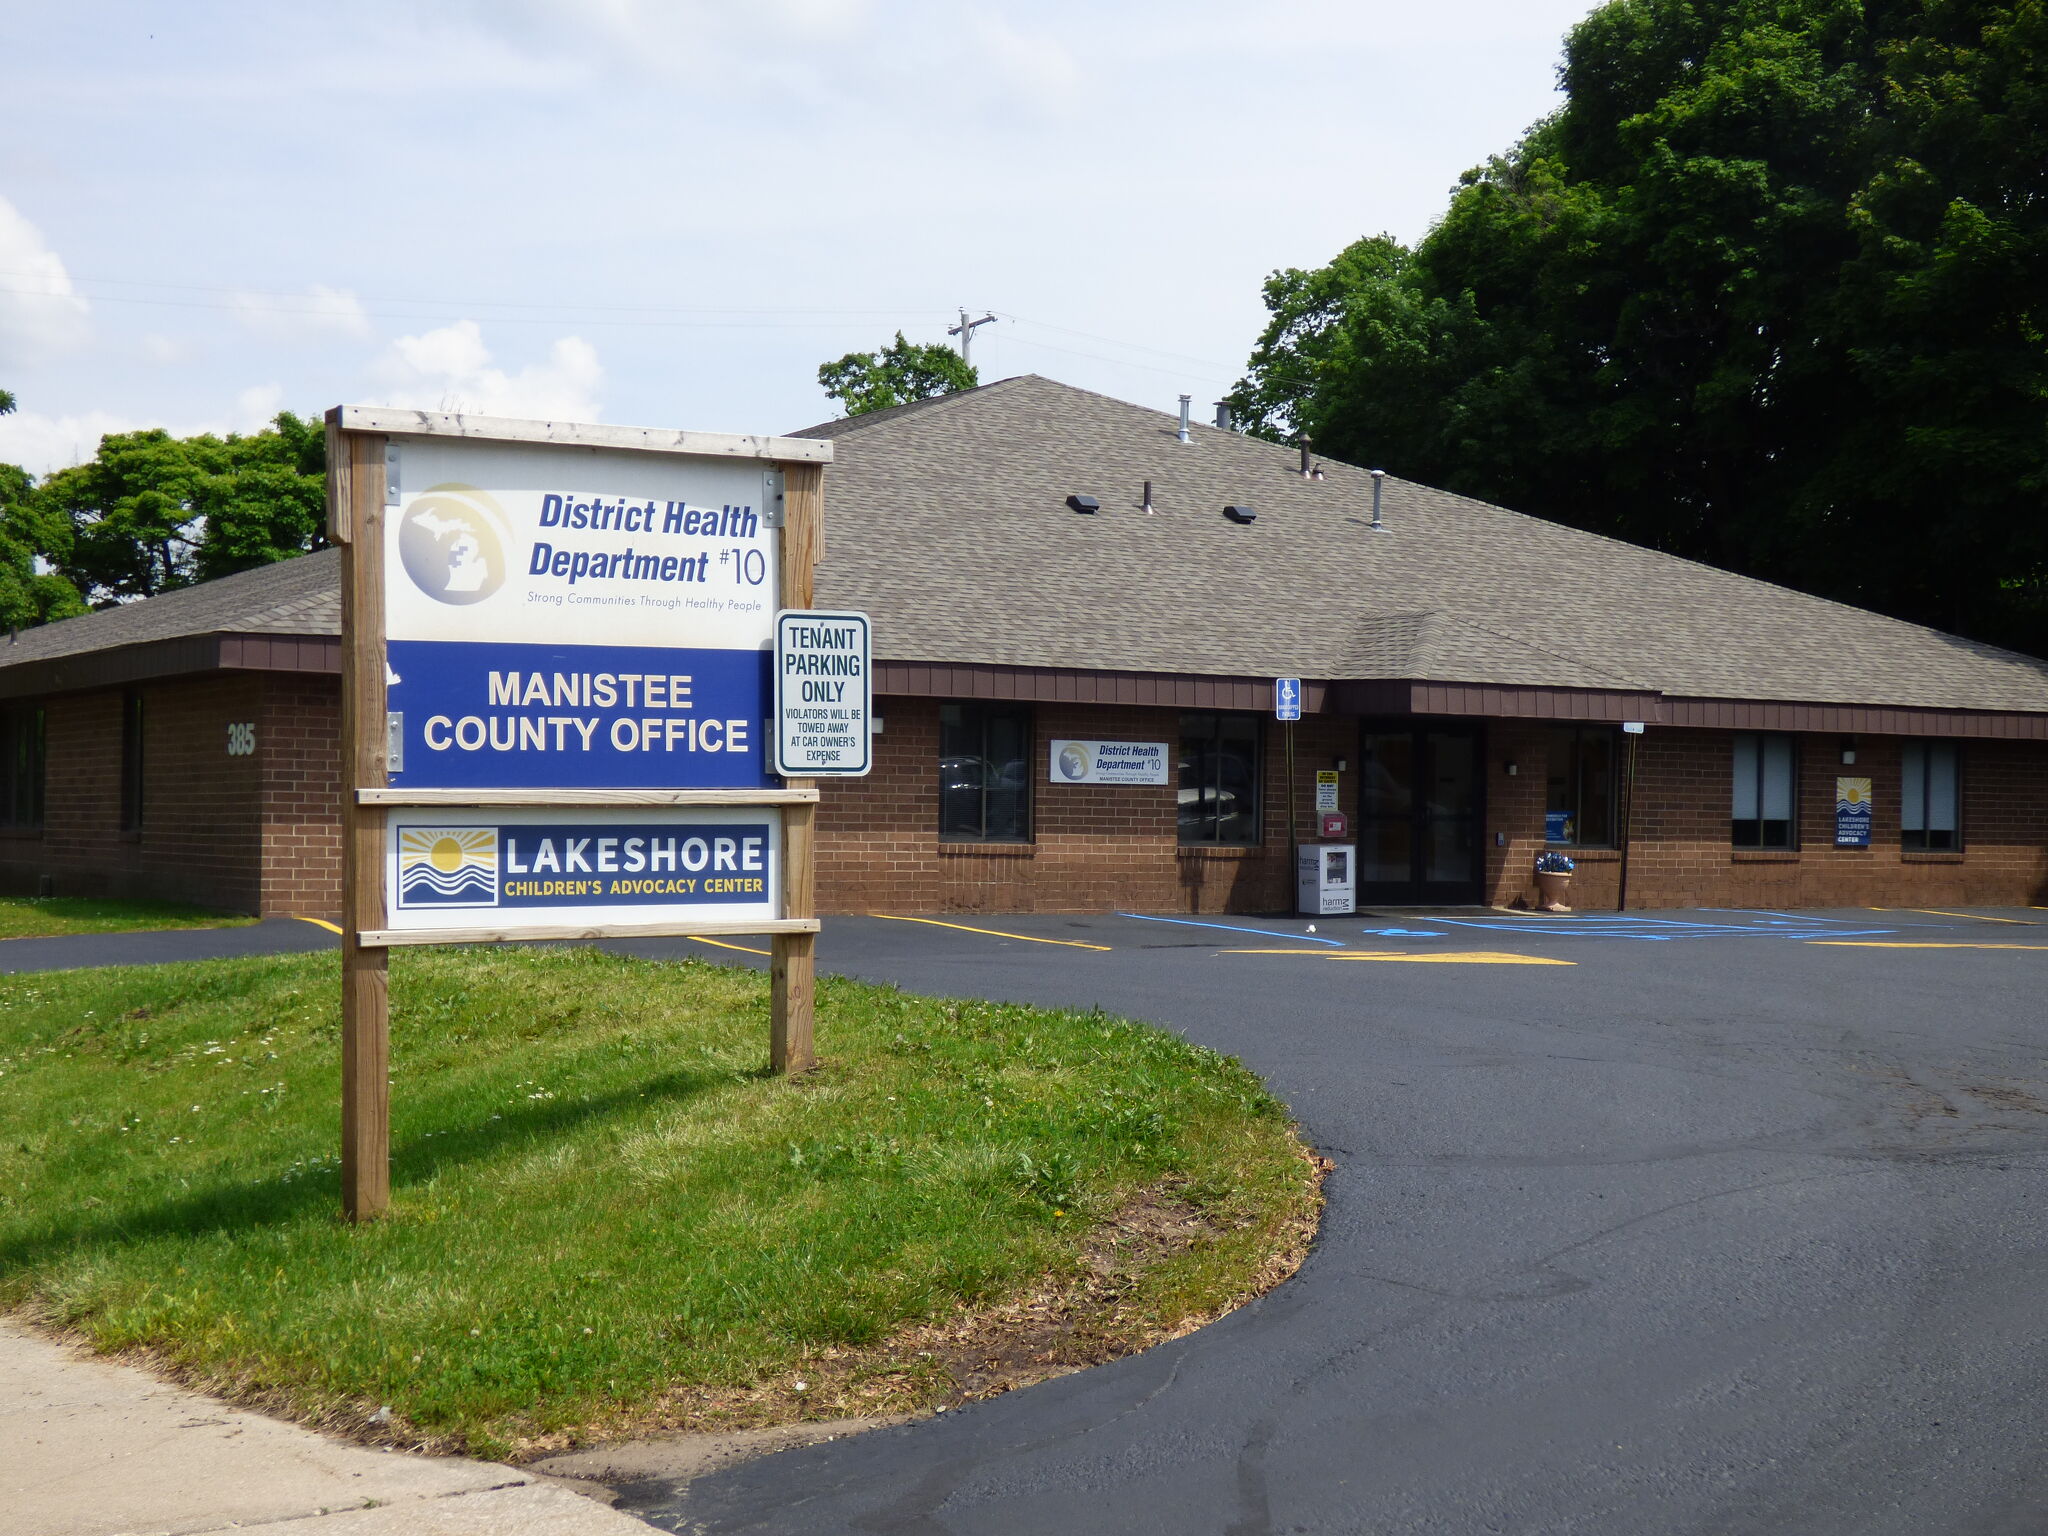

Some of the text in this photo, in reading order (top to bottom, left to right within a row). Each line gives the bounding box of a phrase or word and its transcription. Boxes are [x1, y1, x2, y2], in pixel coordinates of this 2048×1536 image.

[539, 494, 757, 538] District Health
[529, 542, 765, 585] Department #10
[528, 591, 761, 613] Strong Communities Through Healthy People
[789, 626, 856, 649] TENANT
[786, 654, 860, 676] PARKING
[488, 671, 692, 709] MANISTEE
[802, 681, 845, 702] ONLY
[786, 708, 861, 720] VIOLATORS WILL BE
[424, 715, 748, 753] COUNTY OFFICE
[798, 722, 849, 733] TOWED AWAY
[228, 722, 256, 756] 385
[791, 736, 855, 748] AT CAR OWNER'S
[806, 750, 841, 761] EXPENSE
[1099, 745, 1159, 757] District Health
[1096, 759, 1145, 771] Department
[507, 837, 763, 873] LAKESHORE
[505, 878, 763, 897] CHILDREN'S ADVOCACY CENTER
[1322, 897, 1342, 906] harm
